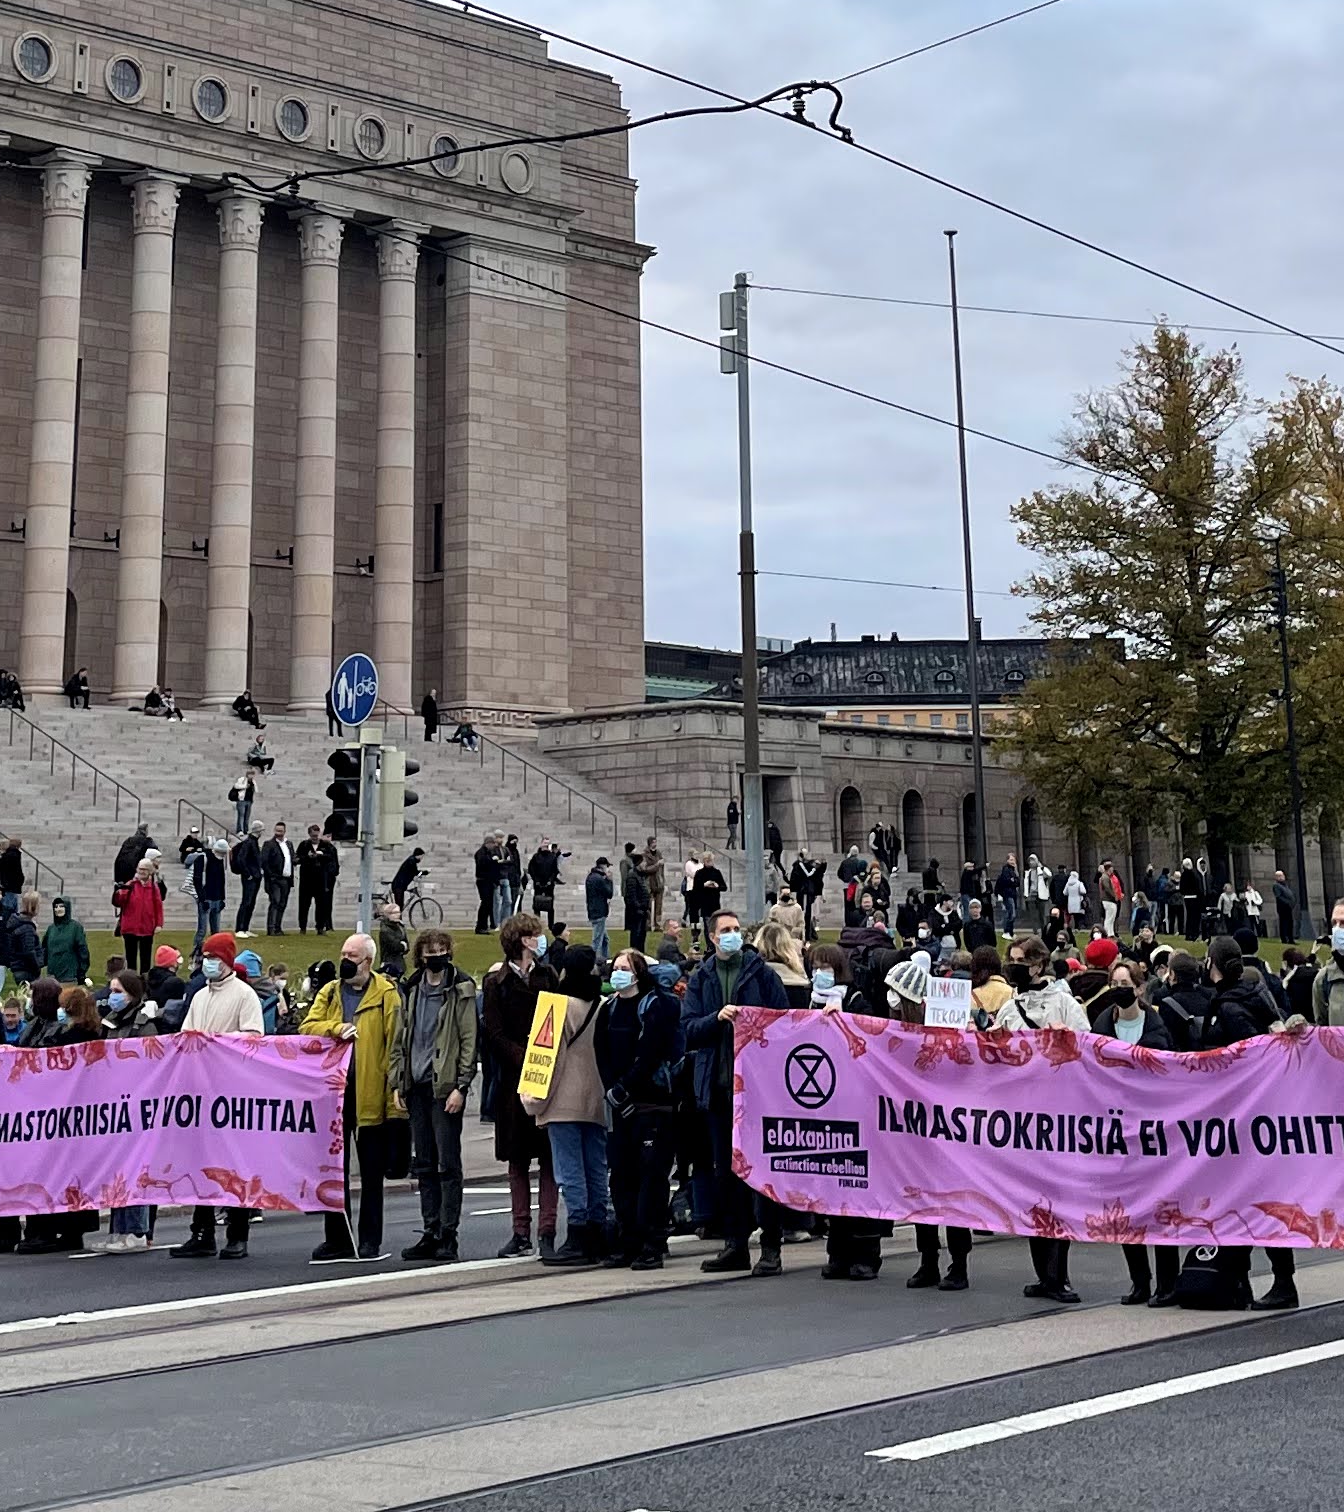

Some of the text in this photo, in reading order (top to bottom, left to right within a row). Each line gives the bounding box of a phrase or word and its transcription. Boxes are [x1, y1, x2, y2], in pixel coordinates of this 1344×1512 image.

[930, 1007, 967, 1026] TEKOJA
[161, 1094, 202, 1128] VOI
[210, 1095, 317, 1134] OHITTAA
[878, 1094, 1128, 1156] ILMASTOKRIISIÄ
[1139, 1120, 1168, 1156] EI
[1176, 1117, 1240, 1157] VOI
[767, 1120, 854, 1151] elokapina
[773, 1157, 866, 1176] extinction rebellion
